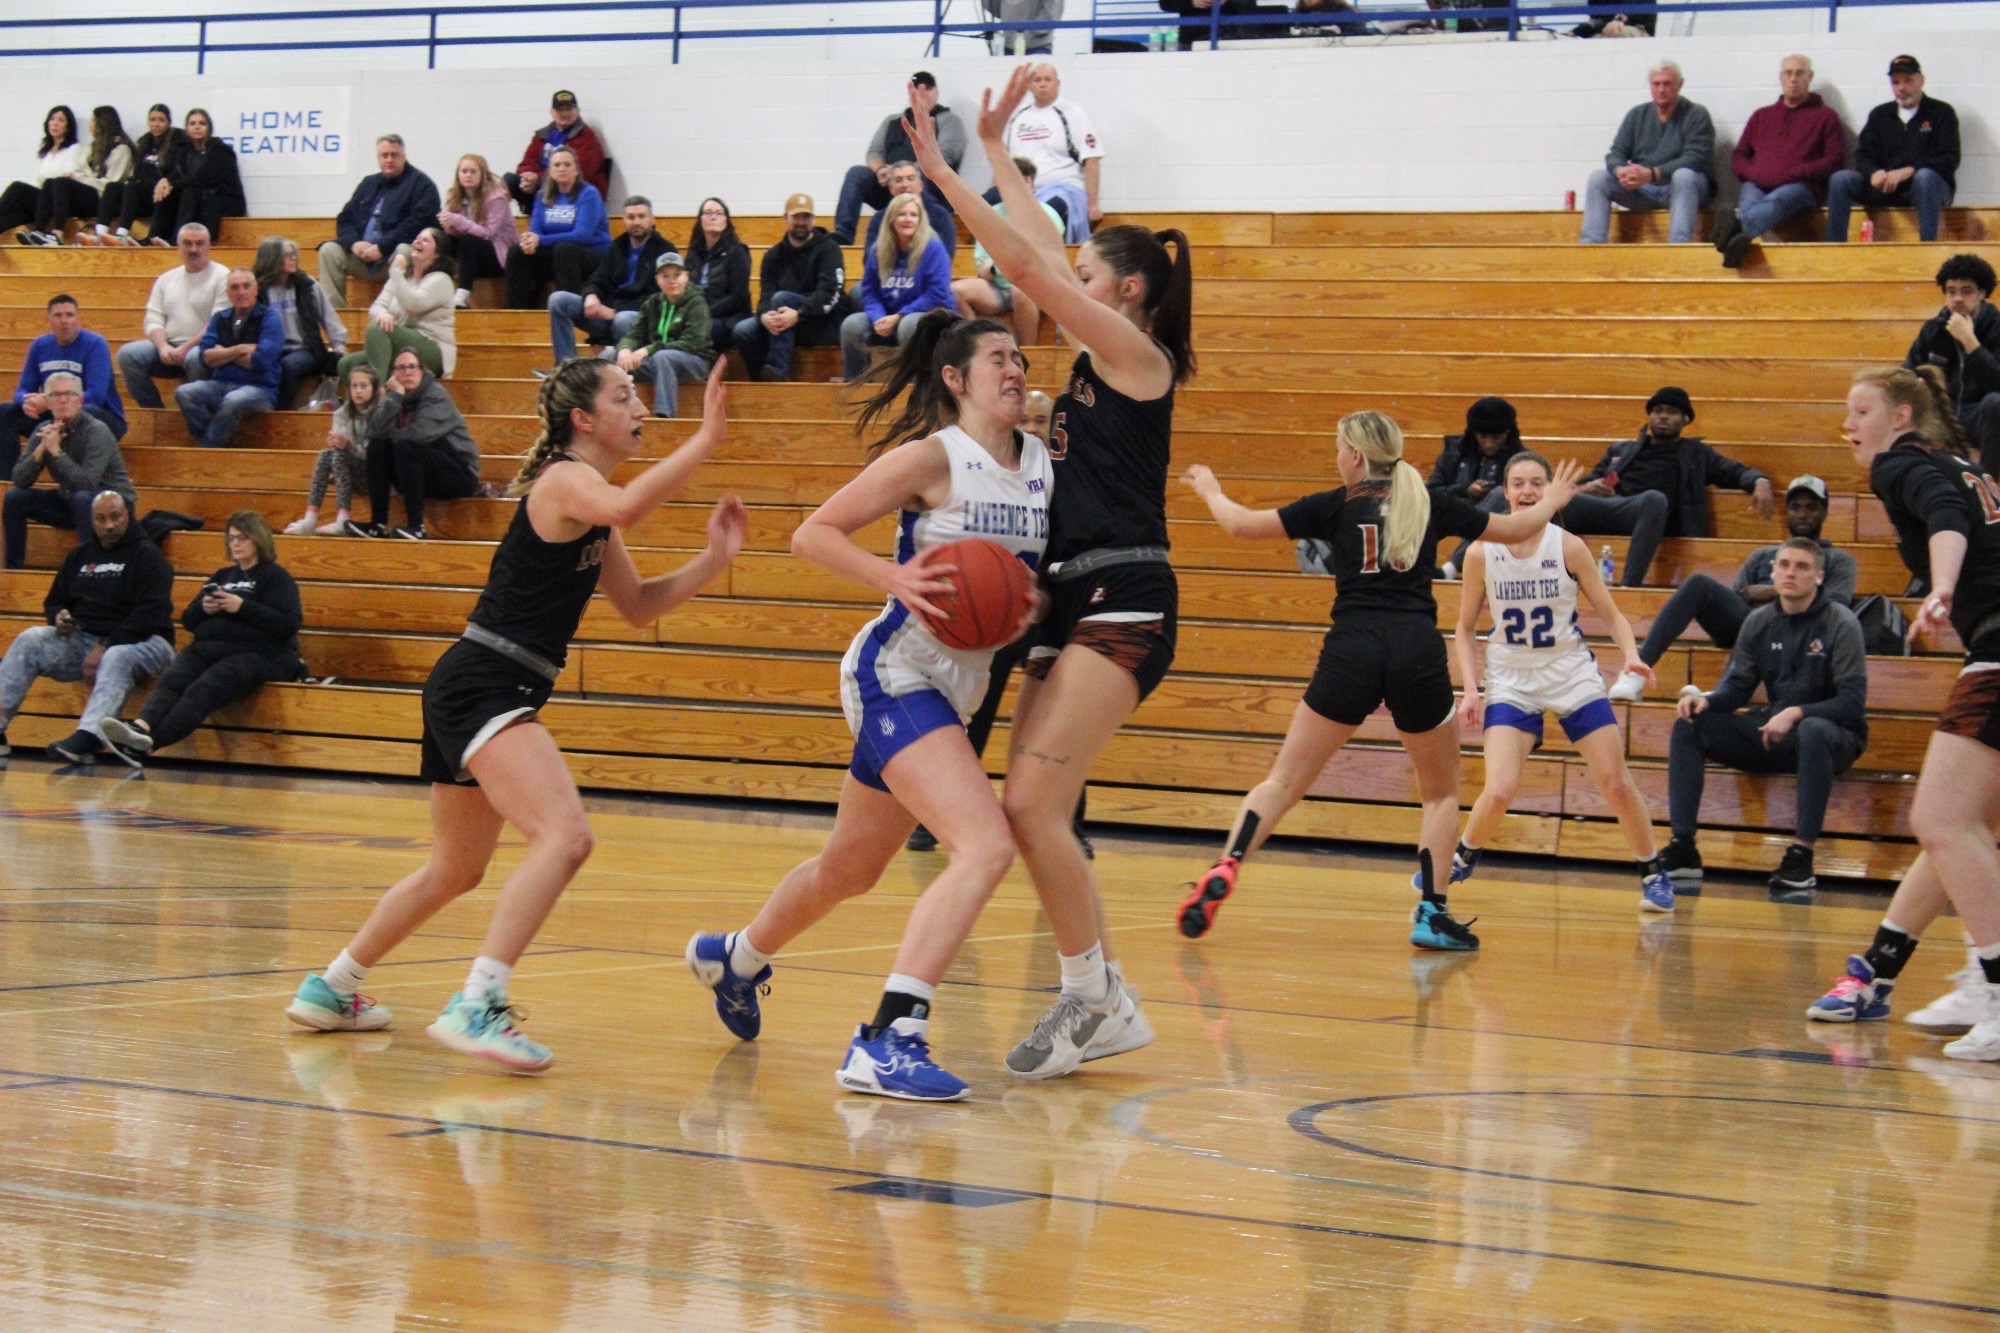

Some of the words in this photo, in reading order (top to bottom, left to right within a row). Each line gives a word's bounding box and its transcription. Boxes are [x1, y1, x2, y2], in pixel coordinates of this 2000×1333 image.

[240, 110, 322, 129] HOME
[963, 500, 1028, 536] LAWRENCE
[1494, 579, 1537, 600] LAWRENCE
[1540, 578, 1559, 598] TECH
[1502, 605, 1555, 649] 22
